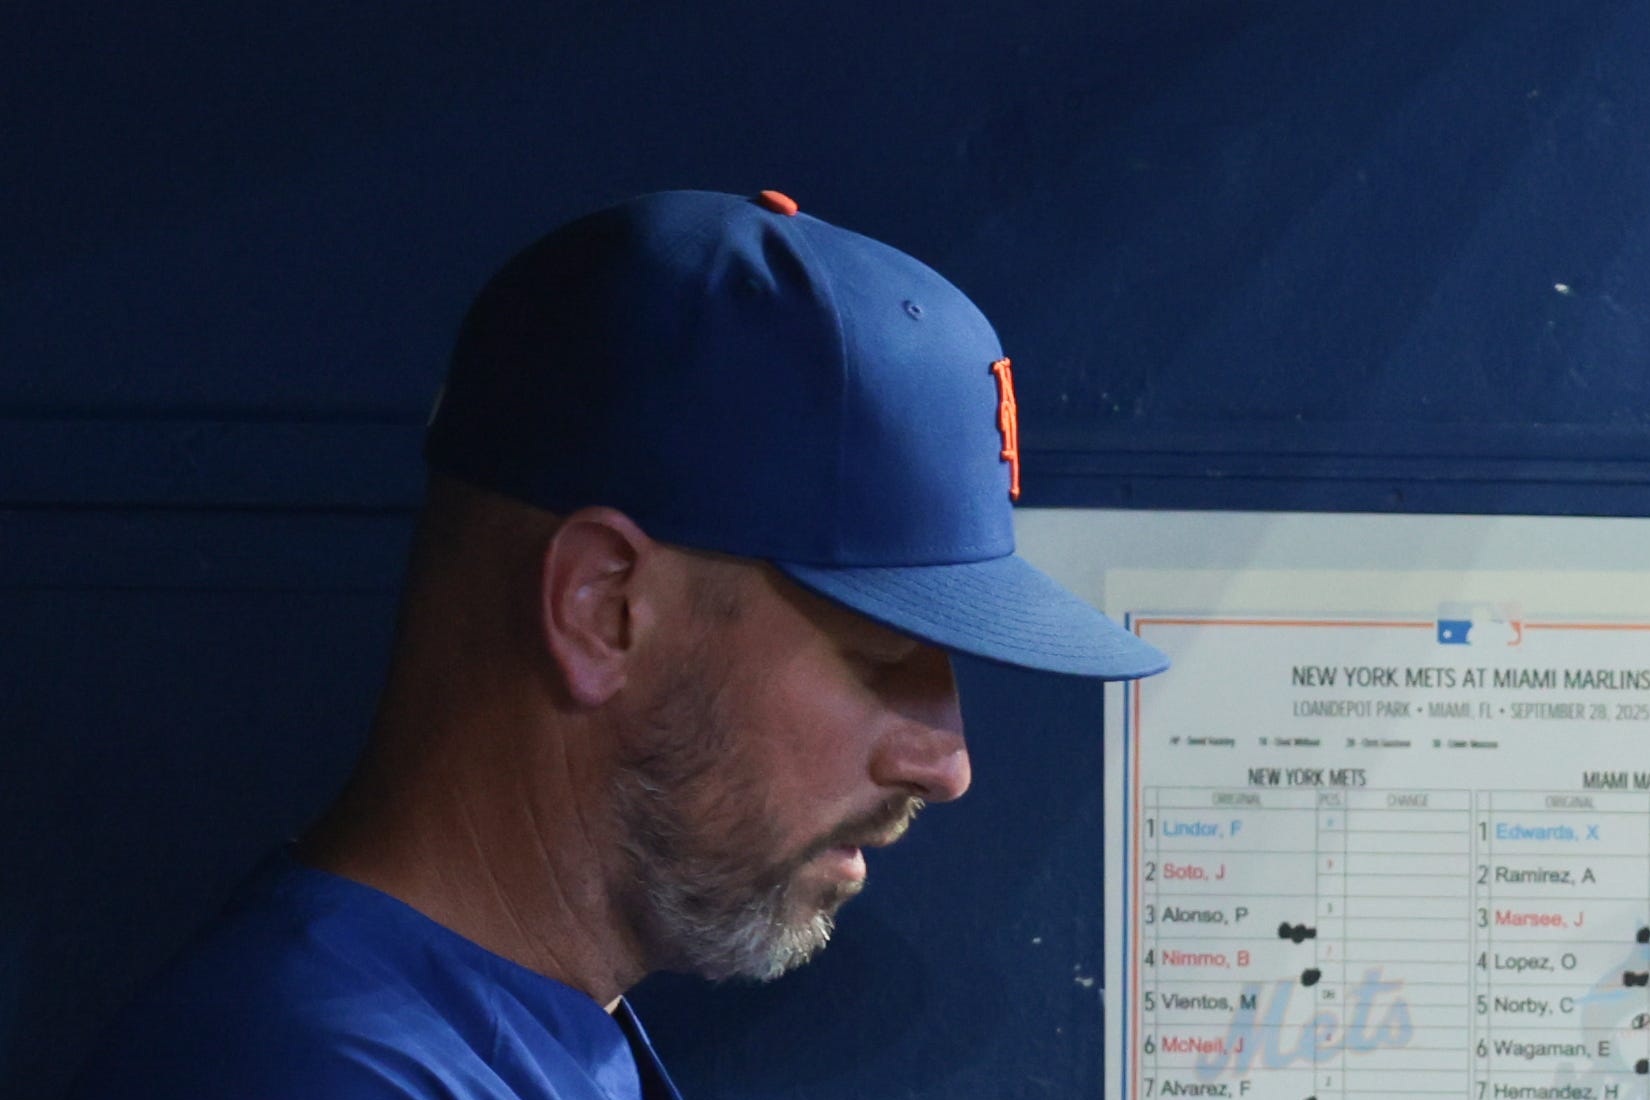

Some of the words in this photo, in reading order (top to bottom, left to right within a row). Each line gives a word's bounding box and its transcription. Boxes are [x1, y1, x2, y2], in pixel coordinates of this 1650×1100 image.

[1291, 666, 1340, 688] NEW
[1345, 666, 1399, 688] YORK
[1405, 667, 1458, 689] METS
[1462, 667, 1486, 689] AT
[1493, 667, 1558, 690] MIAMI
[1293, 699, 1370, 717] LOANDEPOT
[1375, 699, 1411, 718] PARK
[1428, 700, 1474, 721] MIAMI,
[1479, 700, 1494, 719] FL
[1511, 701, 1585, 720] SEPTEMBER
[1615, 702, 1650, 720] 2025
[1248, 769, 1280, 785] NEW
[1287, 769, 1324, 785] YORK
[1330, 769, 1367, 786] METS
[1583, 772, 1629, 789] MIAMI
[1147, 819, 1155, 837] 1
[1162, 820, 1225, 838] Lindor,
[1231, 821, 1243, 836] F
[1479, 822, 1488, 840] 1
[1496, 823, 1580, 842] Edwards,
[1586, 824, 1600, 840] X
[1145, 863, 1156, 881] 2
[1163, 864, 1208, 880] Soto,
[1215, 864, 1225, 879] J
[1476, 866, 1488, 884] 2
[1495, 867, 1576, 886] Ramirez,
[1582, 868, 1595, 883] A
[1145, 906, 1155, 924] 3
[1162, 908, 1229, 925] Alonso,
[1236, 908, 1248, 922] P
[1477, 909, 1488, 927] 3
[1495, 911, 1567, 928] Marsee,
[1574, 911, 1584, 927] J
[1144, 948, 1155, 966] 4
[1162, 950, 1230, 968] Nimmo,
[1238, 951, 1250, 966] B
[1476, 952, 1488, 970] 4
[1495, 953, 1554, 973] Lopez,
[1561, 953, 1577, 970] O
[1145, 992, 1155, 1010] 5
[1162, 994, 1234, 1012] Vientos,
[1240, 995, 1257, 1010] M
[1476, 996, 1488, 1014] 5
[1494, 997, 1553, 1017] Norby,
[1560, 997, 1574, 1013] C
[1144, 1035, 1155, 1053] 6
[1161, 1037, 1229, 1054] McNeil,
[1234, 1038, 1244, 1053] J
[1476, 1039, 1488, 1058] 6
[1494, 1041, 1592, 1061] Wagaman,
[1599, 1041, 1611, 1057] E
[1144, 1079, 1154, 1097] 7
[1161, 1081, 1233, 1098] Alvarez,
[1240, 1082, 1251, 1096] F
[1477, 1082, 1487, 1100] 7
[1604, 1085, 1619, 1100] H
